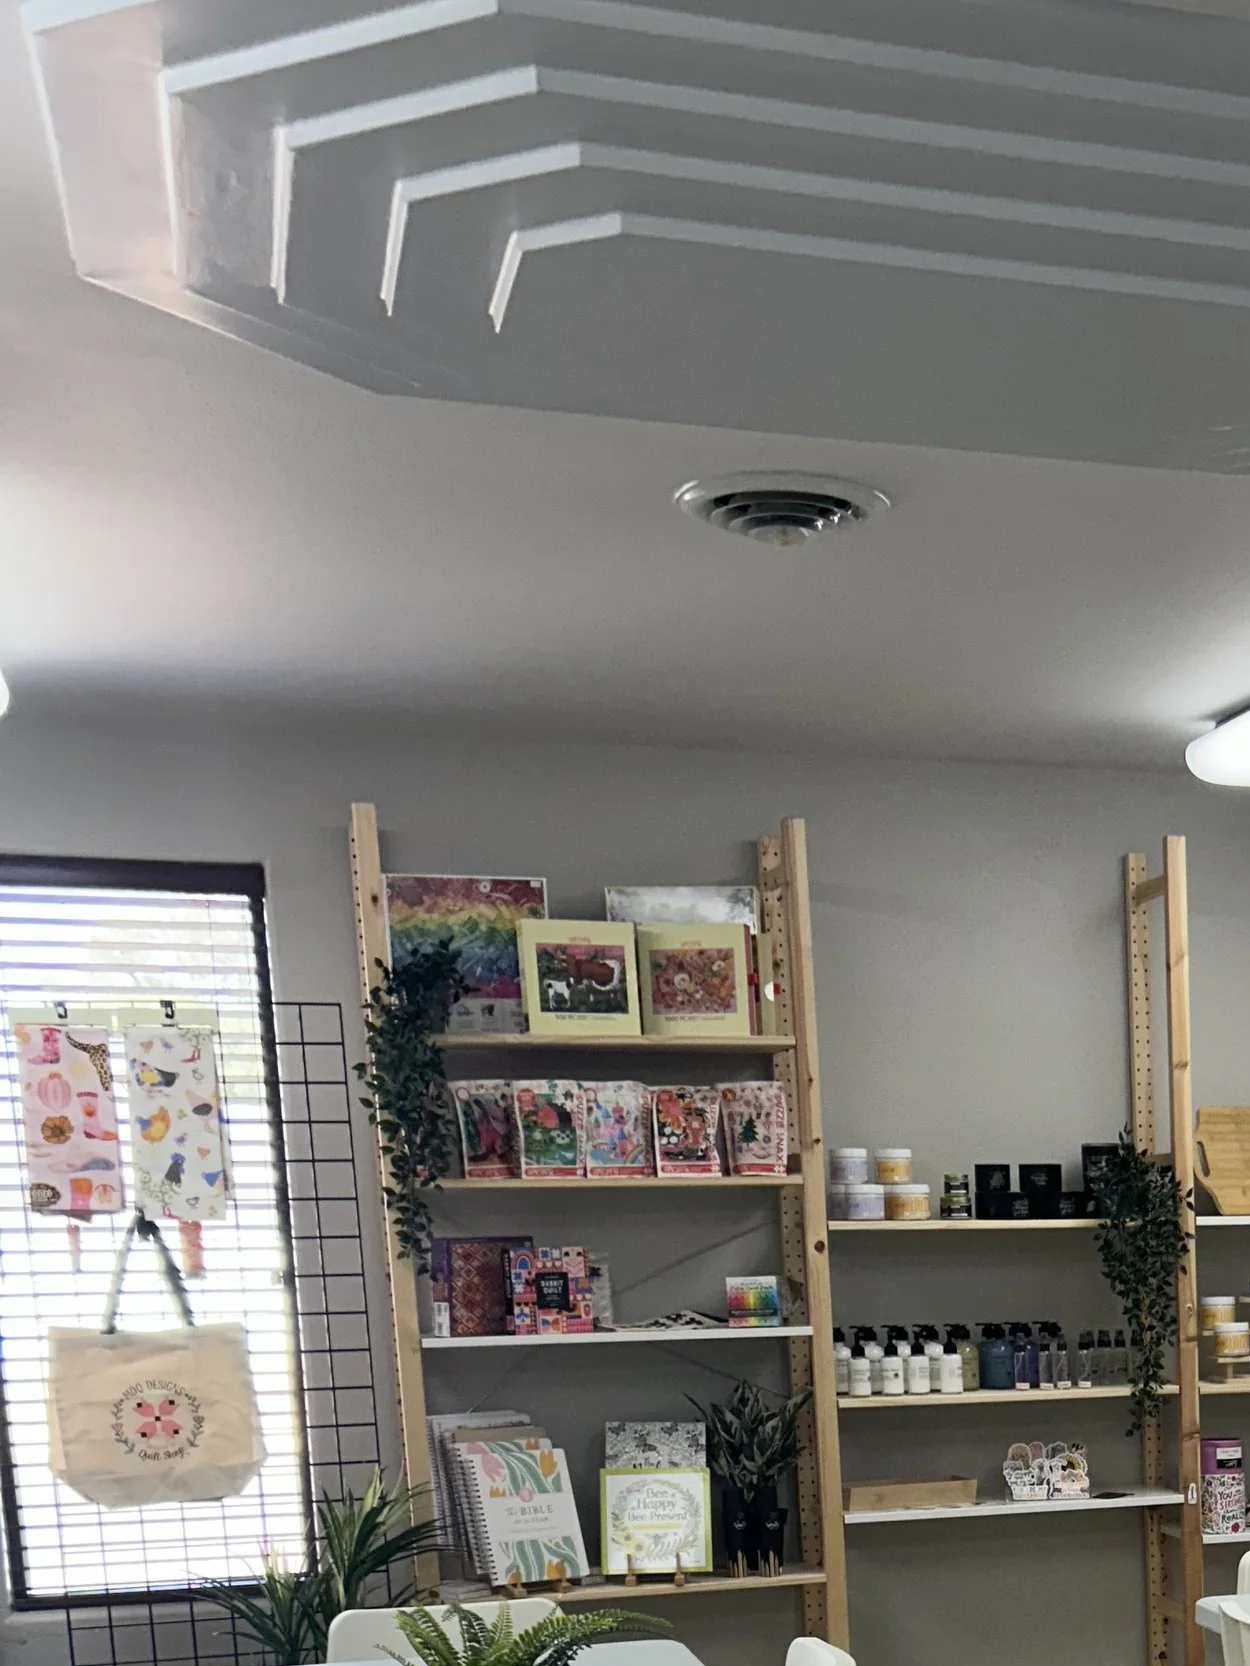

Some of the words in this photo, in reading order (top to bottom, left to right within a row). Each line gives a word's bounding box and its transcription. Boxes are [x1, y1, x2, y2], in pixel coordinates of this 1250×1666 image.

[145, 1380, 185, 1396] DESIGNS
[139, 1449, 161, 1461] Quilt
[646, 1487, 669, 1498] Bee
[1217, 1491, 1233, 1501] YOU
[520, 1504, 554, 1516] BIBLE
[637, 1498, 677, 1512] Happy
[628, 1511, 647, 1521] Bee
[650, 1511, 688, 1521] Present
